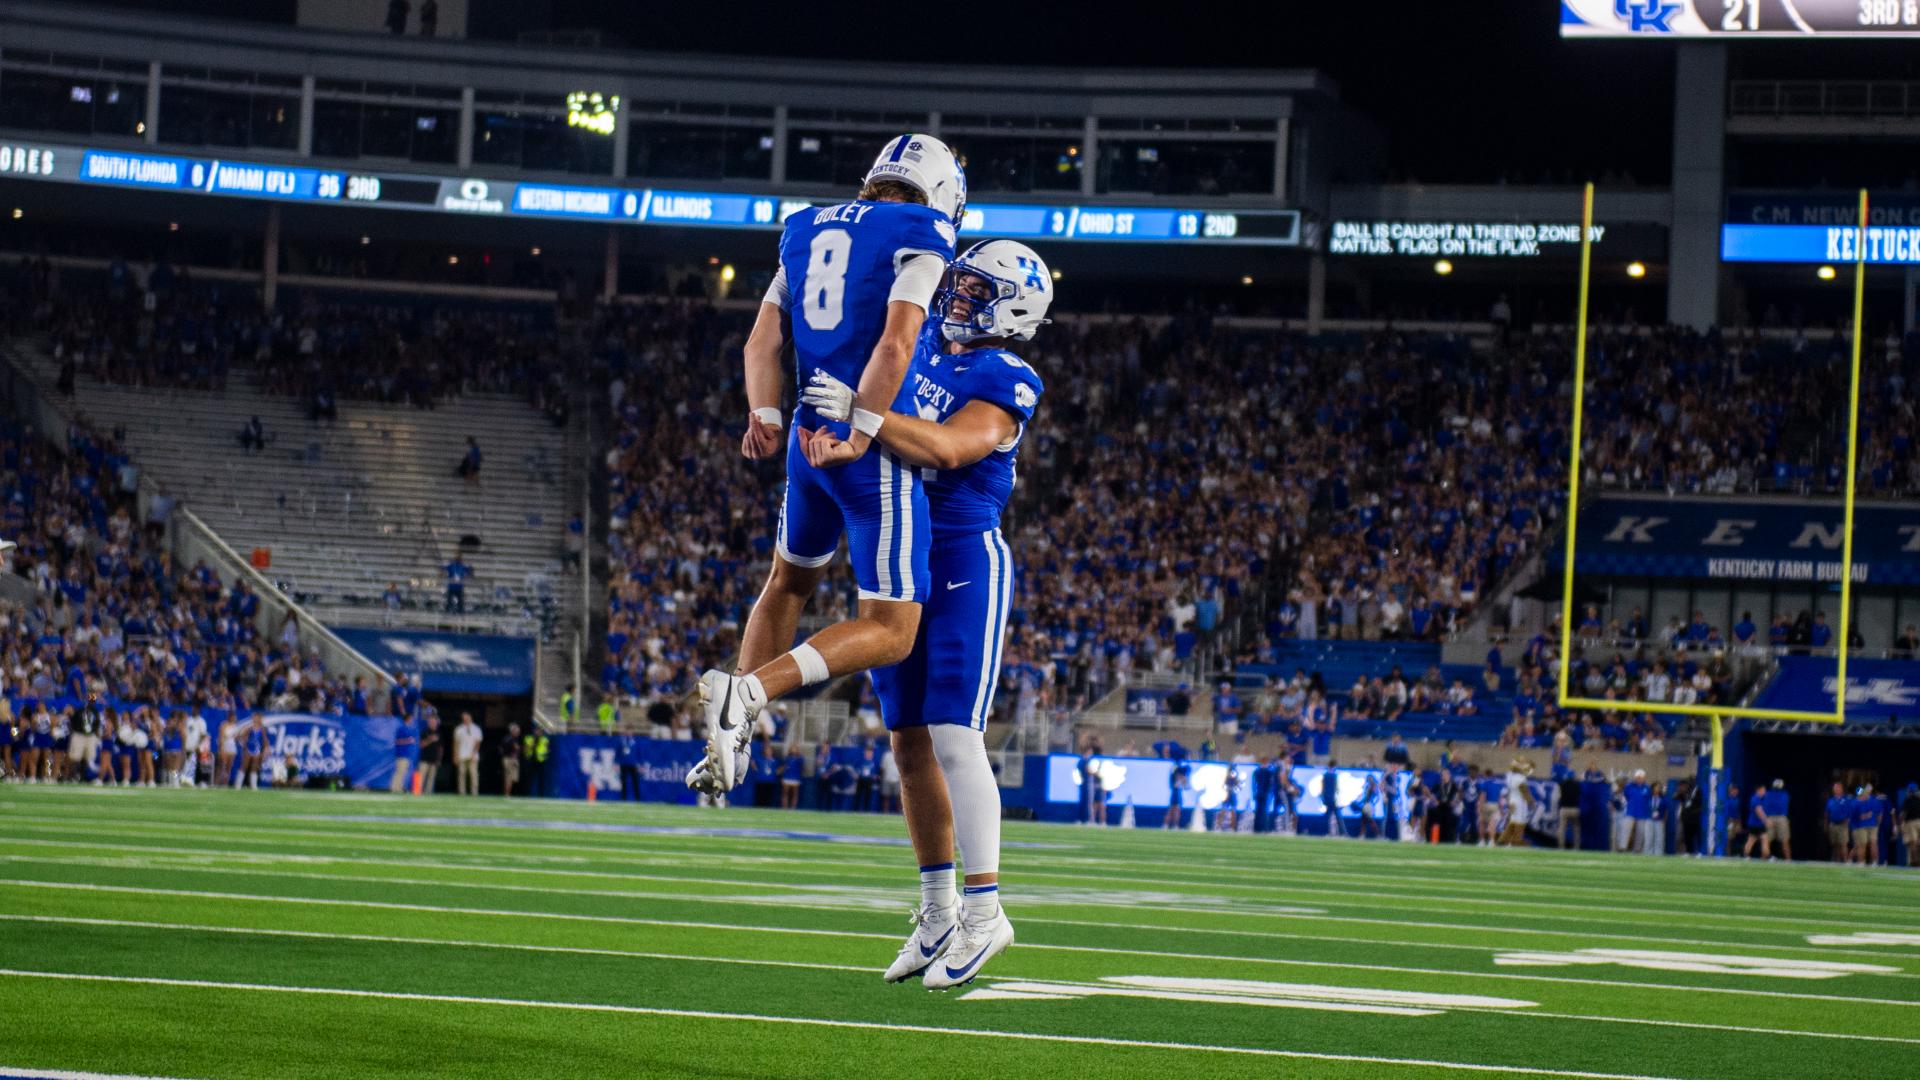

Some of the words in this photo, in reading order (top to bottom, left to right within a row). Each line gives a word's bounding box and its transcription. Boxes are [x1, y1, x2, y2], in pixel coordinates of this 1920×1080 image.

[1721, 0, 1760, 31] 21
[1858, 0, 1900, 25] 3RD
[88, 155, 128, 179] SOUTH
[129, 158, 178, 184] FLORIDA
[218, 166, 264, 191] MIAMI
[265, 170, 295, 194] (FL)
[347, 175, 380, 200] 3RD
[872, 164, 911, 176] KENTUCKY
[652, 196, 713, 219] ILLINOIS
[753, 200, 774, 223] 10
[1803, 207, 1903, 224] NEWON
[1052, 211, 1065, 233] 3
[1079, 213, 1113, 235] OHIO
[1115, 213, 1135, 235] ST
[1179, 215, 1197, 237] 13
[1203, 215, 1238, 237] 2ND
[1334, 222, 1371, 238] BALL
[1373, 223, 1389, 239] IS
[1390, 223, 1454, 240] CAUGHT
[1455, 224, 1473, 240] IN
[1538, 225, 1580, 242] ZONE
[1399, 239, 1439, 254] FLAG
[1440, 240, 1465, 255] ON
[1467, 240, 1497, 255] THE
[803, 228, 853, 331] 8
[1708, 557, 1775, 579] KENTUCKY
[1778, 560, 1813, 580] FARM
[1816, 562, 1868, 583] BURAU
